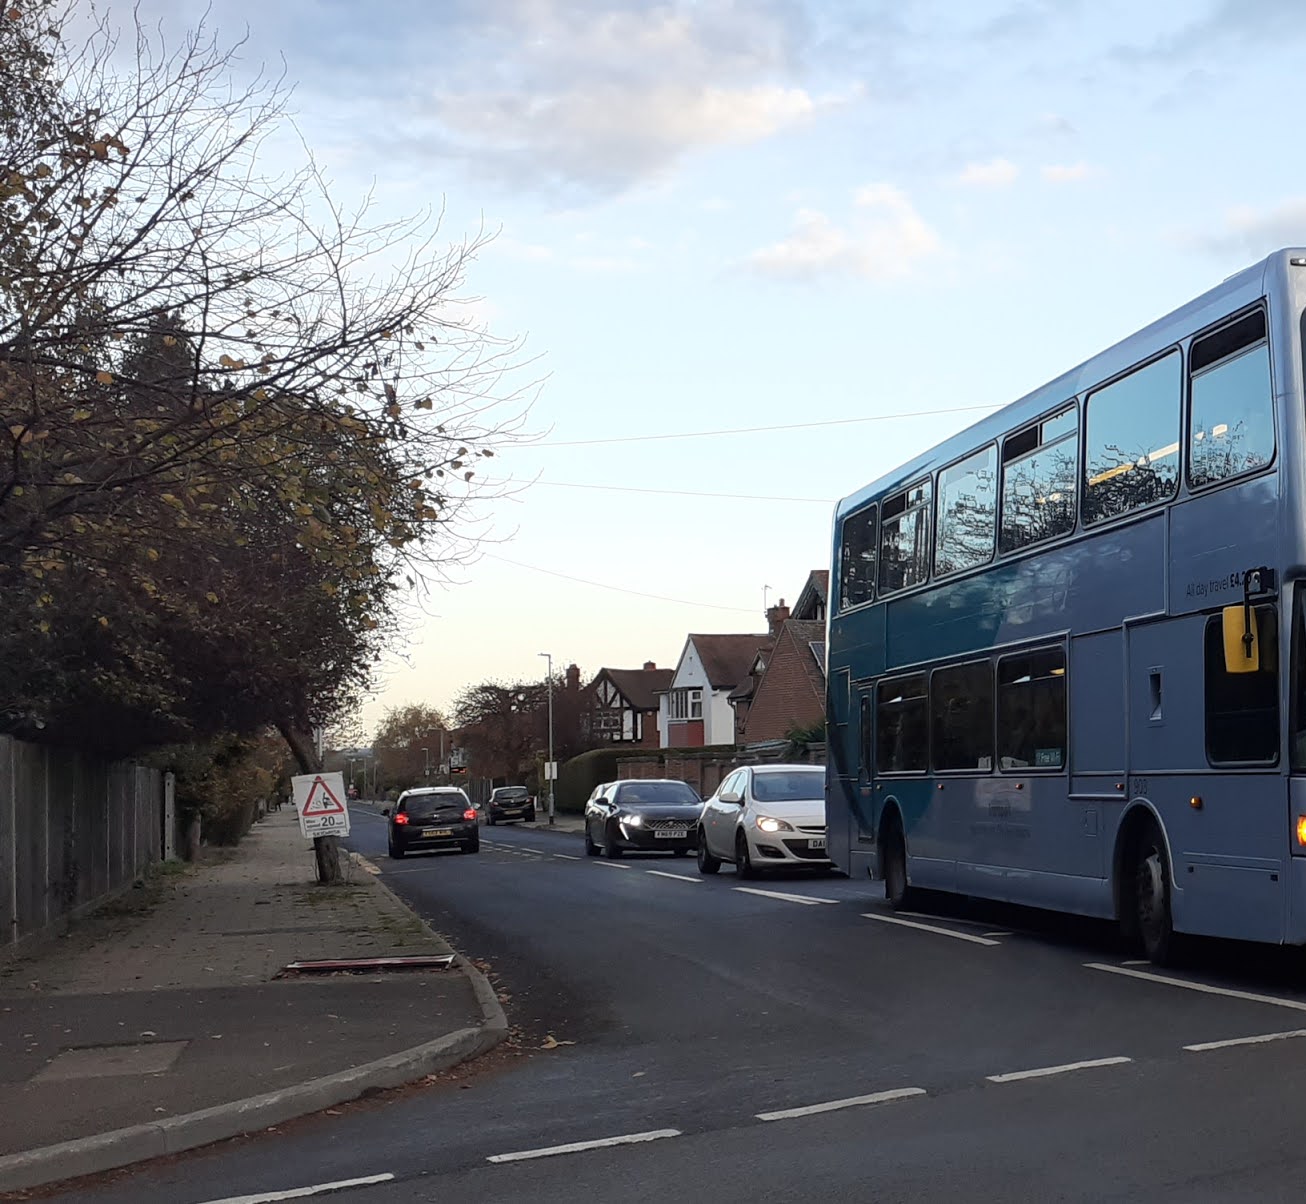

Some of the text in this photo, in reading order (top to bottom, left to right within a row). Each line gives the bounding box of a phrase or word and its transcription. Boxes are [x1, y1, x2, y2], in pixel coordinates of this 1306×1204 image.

[1186, 583, 1195, 597] All
[1196, 583, 1208, 597] day
[1209, 576, 1229, 592] travel
[321, 816, 335, 827] 20
